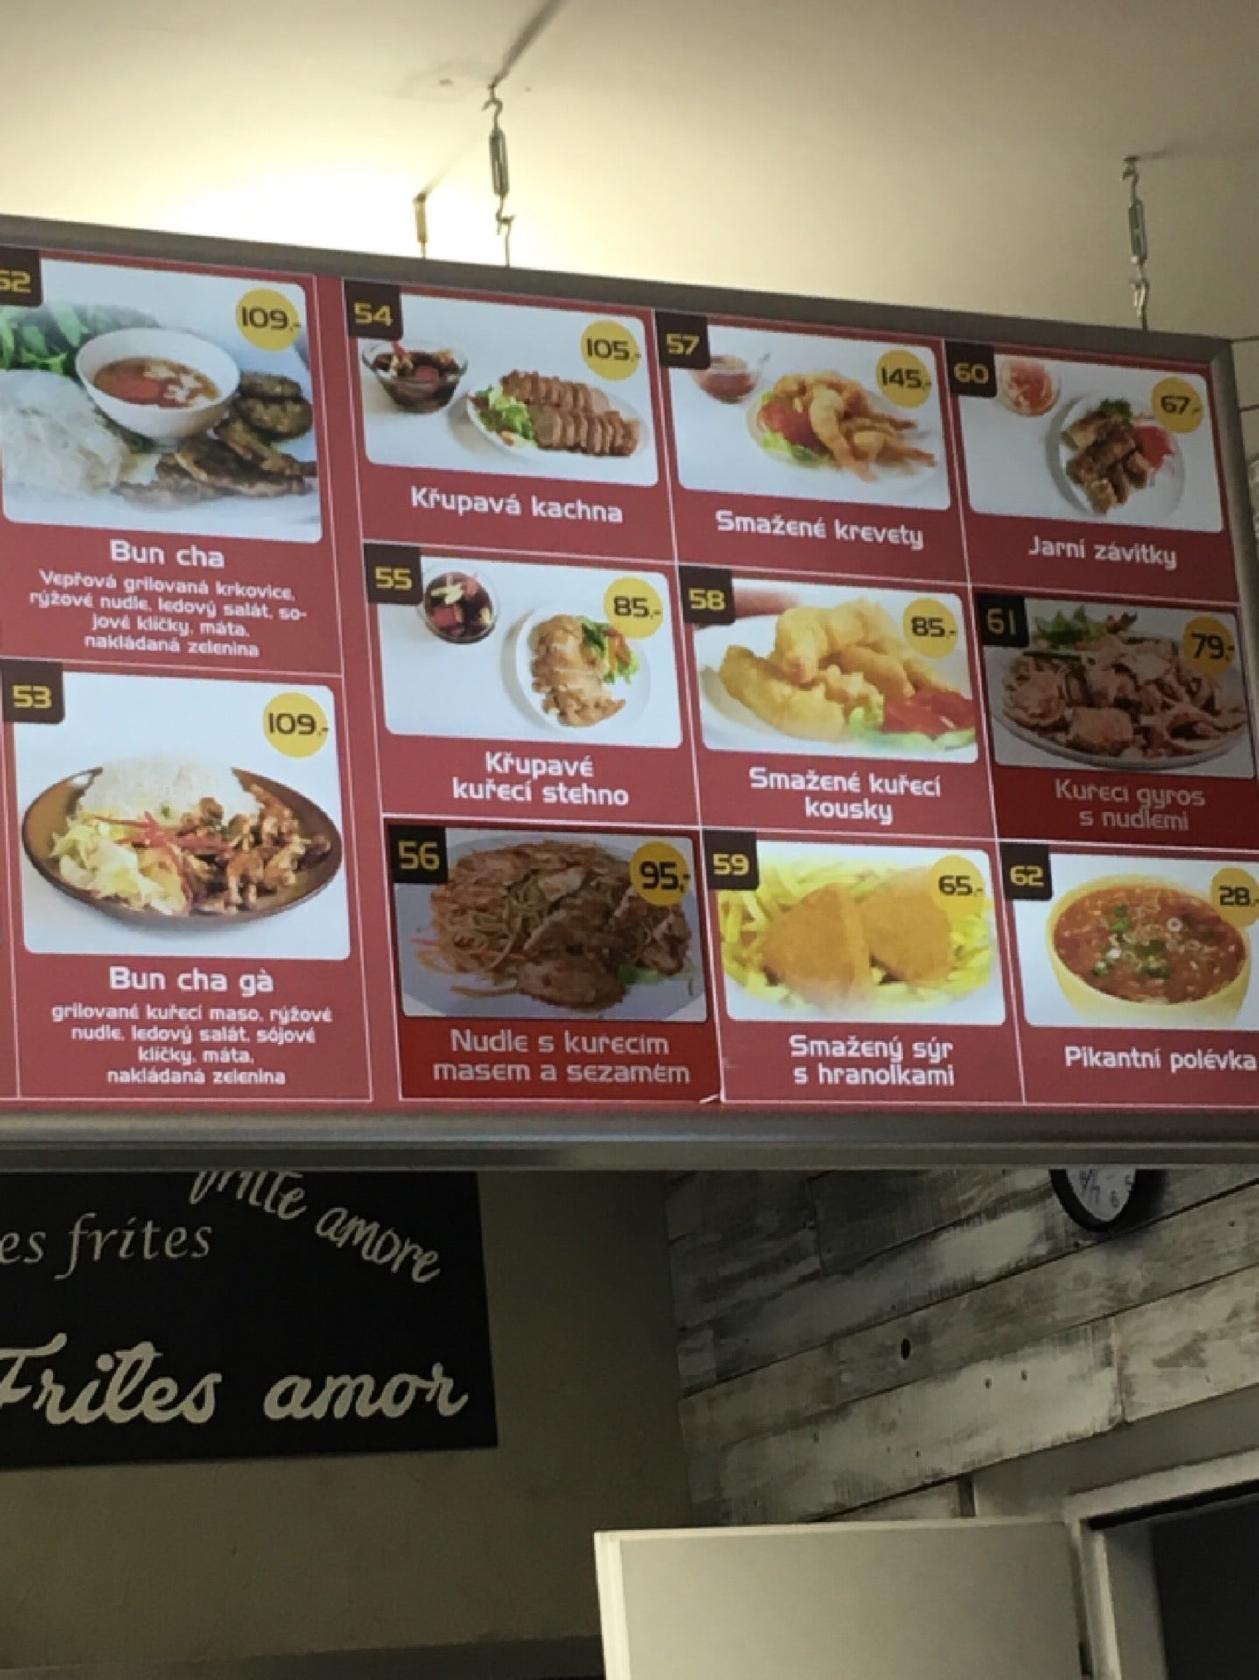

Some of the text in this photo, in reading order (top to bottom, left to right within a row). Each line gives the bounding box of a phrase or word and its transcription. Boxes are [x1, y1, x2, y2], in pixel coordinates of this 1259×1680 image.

[354, 303, 394, 327] 54
[665, 333, 700, 356] 57
[953, 362, 989, 384] 60
[410, 485, 623, 523] Křupavá kachna
[715, 509, 924, 550] Smažené krevety
[110, 539, 225, 567] Bun cha
[1095, 543, 1177, 571] závitky
[39, 570, 117, 590] Vepřová
[124, 575, 208, 596] grilovaná
[375, 567, 412, 590] 55
[30, 591, 93, 611] rýžové
[158, 597, 216, 617] ledový
[689, 589, 726, 611] 58
[986, 608, 1017, 636] 61
[85, 634, 259, 657] nakládaná zelenina
[12, 685, 52, 709] 53
[485, 751, 594, 780] Křupavé
[453, 777, 629, 806] kuřecí stehno
[749, 766, 941, 797] Smažené kuřecí
[805, 796, 893, 825] kousky
[1136, 786, 1206, 811] gyros
[1079, 807, 1188, 831] s nudlemi
[398, 841, 440, 870] 56
[712, 853, 749, 876] 59
[1010, 865, 1044, 887] 62
[110, 966, 165, 990] Bun
[178, 968, 228, 990] cha
[52, 1003, 139, 1022] grilované
[270, 1006, 333, 1026] rýžové
[132, 1024, 192, 1043] ledový
[257, 1026, 316, 1046] sójové
[450, 1029, 529, 1054] Nudle
[539, 1036, 554, 1053] s
[789, 1034, 954, 1063] Smažený sýr
[1065, 1045, 1257, 1074] Pikantní polévka
[107, 1066, 286, 1085] nakládaná zelenina
[433, 1063, 530, 1082] masem
[541, 1064, 557, 1081] a
[793, 1063, 954, 1086] s hranolkami
[54, 1212, 213, 1279] frites
[316, 1207, 441, 1284] amore
[0, 1333, 468, 1425] Frites amor
